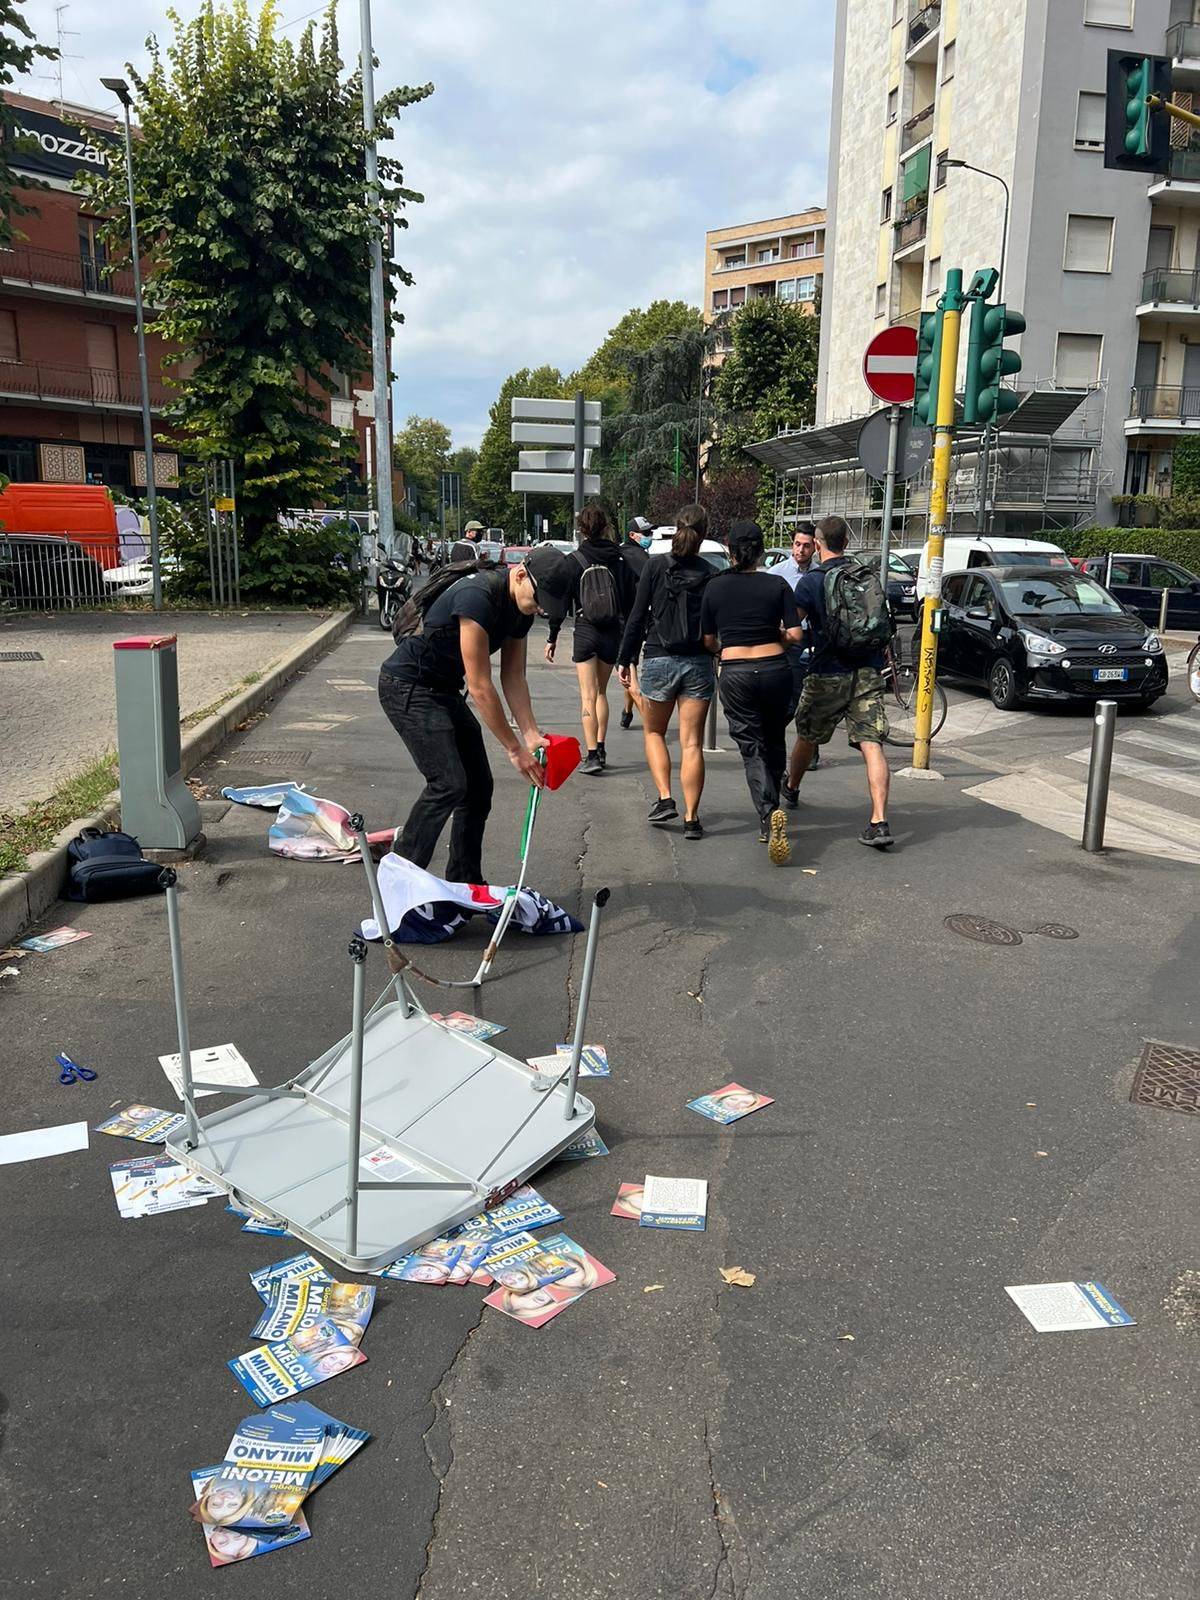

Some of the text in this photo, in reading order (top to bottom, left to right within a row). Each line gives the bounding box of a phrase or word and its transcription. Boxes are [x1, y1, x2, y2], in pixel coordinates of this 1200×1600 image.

[490, 1198, 543, 1220] MELONI
[500, 1207, 552, 1228] MILANO
[484, 1244, 542, 1271] MELONI
[270, 1284, 300, 1338] MILANO
[250, 1353, 289, 1396] MILANO
[271, 1343, 315, 1387] MELONI
[233, 1445, 313, 1463] MILANO
[221, 1466, 306, 1486] MELONI
